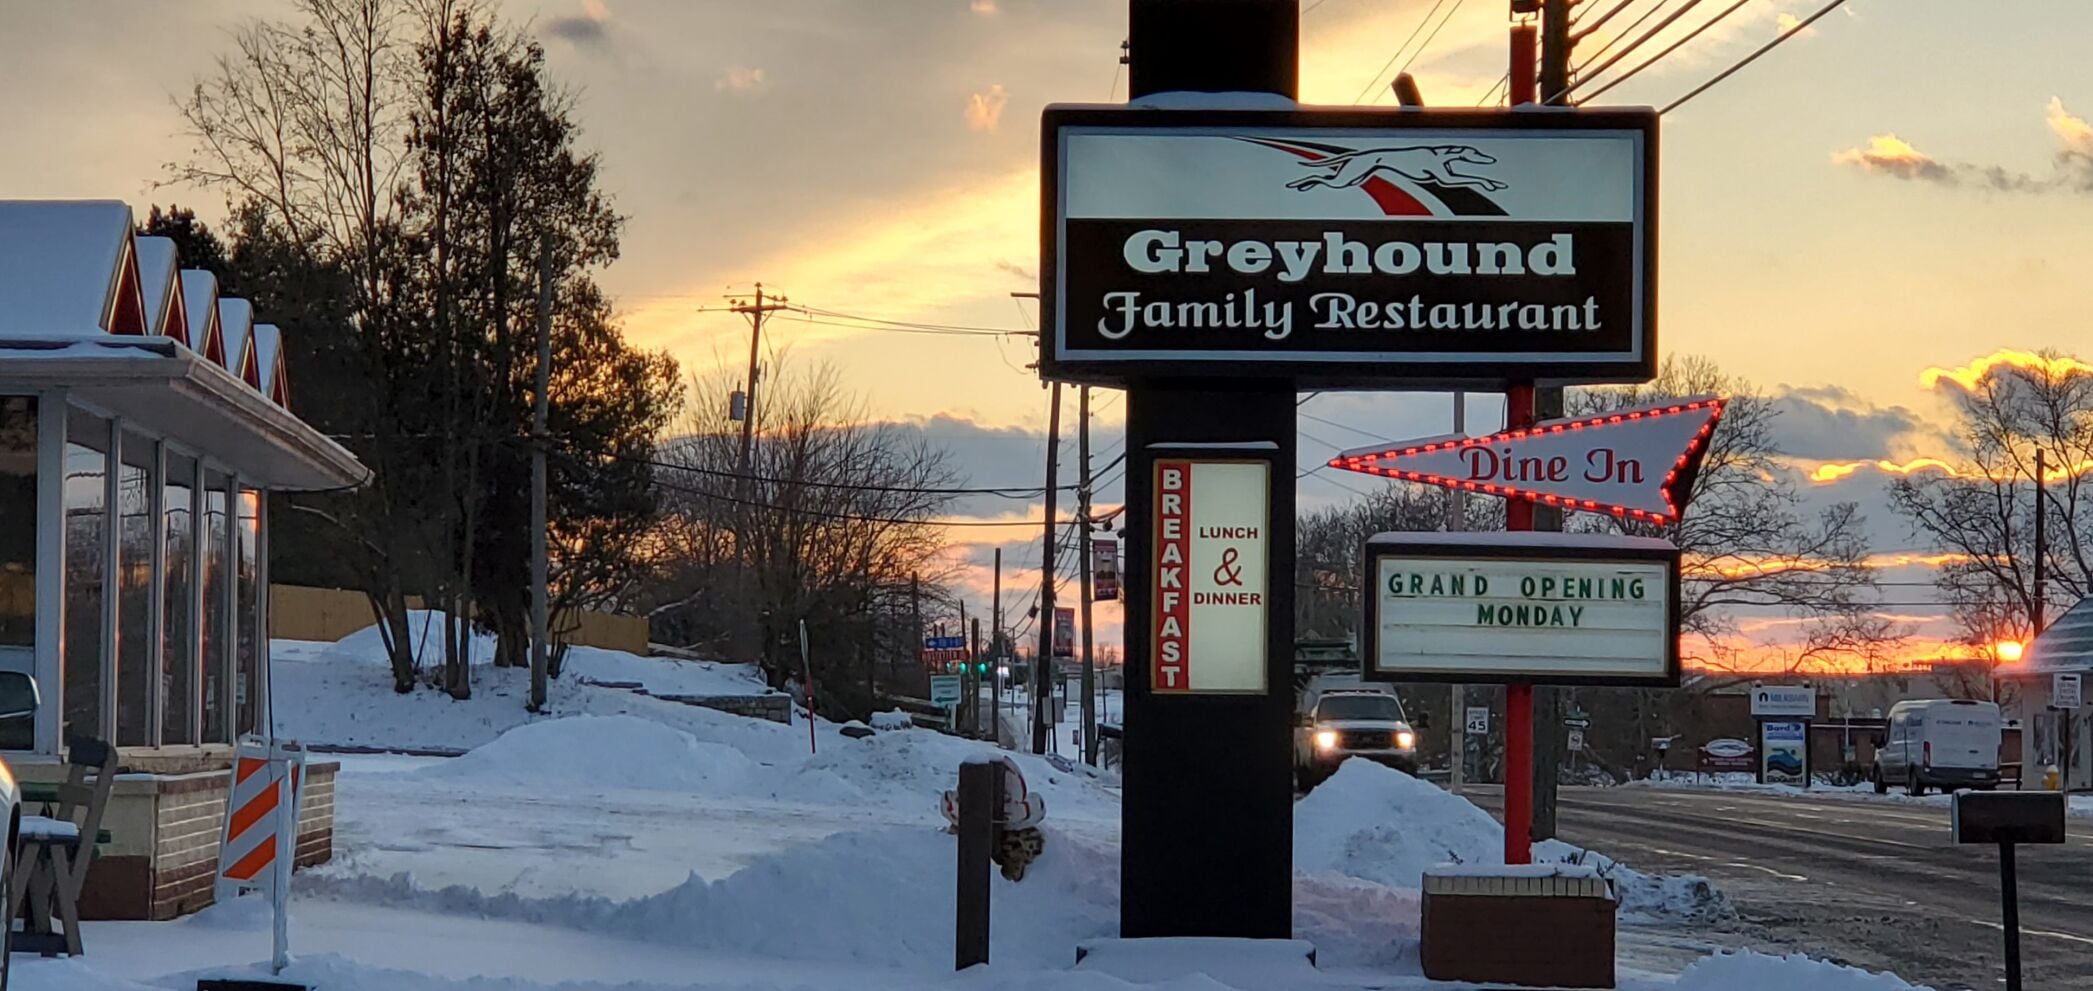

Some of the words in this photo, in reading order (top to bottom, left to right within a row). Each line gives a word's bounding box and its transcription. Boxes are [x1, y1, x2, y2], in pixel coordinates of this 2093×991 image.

[1123, 229, 1577, 282] Greyhound
[1097, 287, 1294, 340] Family
[1309, 291, 1602, 332] Restaurant
[1459, 445, 1570, 482] Dine
[1584, 447, 1645, 484] In
[1199, 526, 1258, 539] LUNCH
[1160, 468, 1184, 688] BREAKFAST
[1213, 547, 1242, 586] &
[1193, 592, 1262, 605] DINNER
[1388, 573, 1488, 596] GRAND
[1521, 577, 1646, 600] OPENING
[1476, 603, 1585, 627] MONDAY
[1468, 721, 1486, 731] 45
[1766, 724, 1790, 732] Bard
